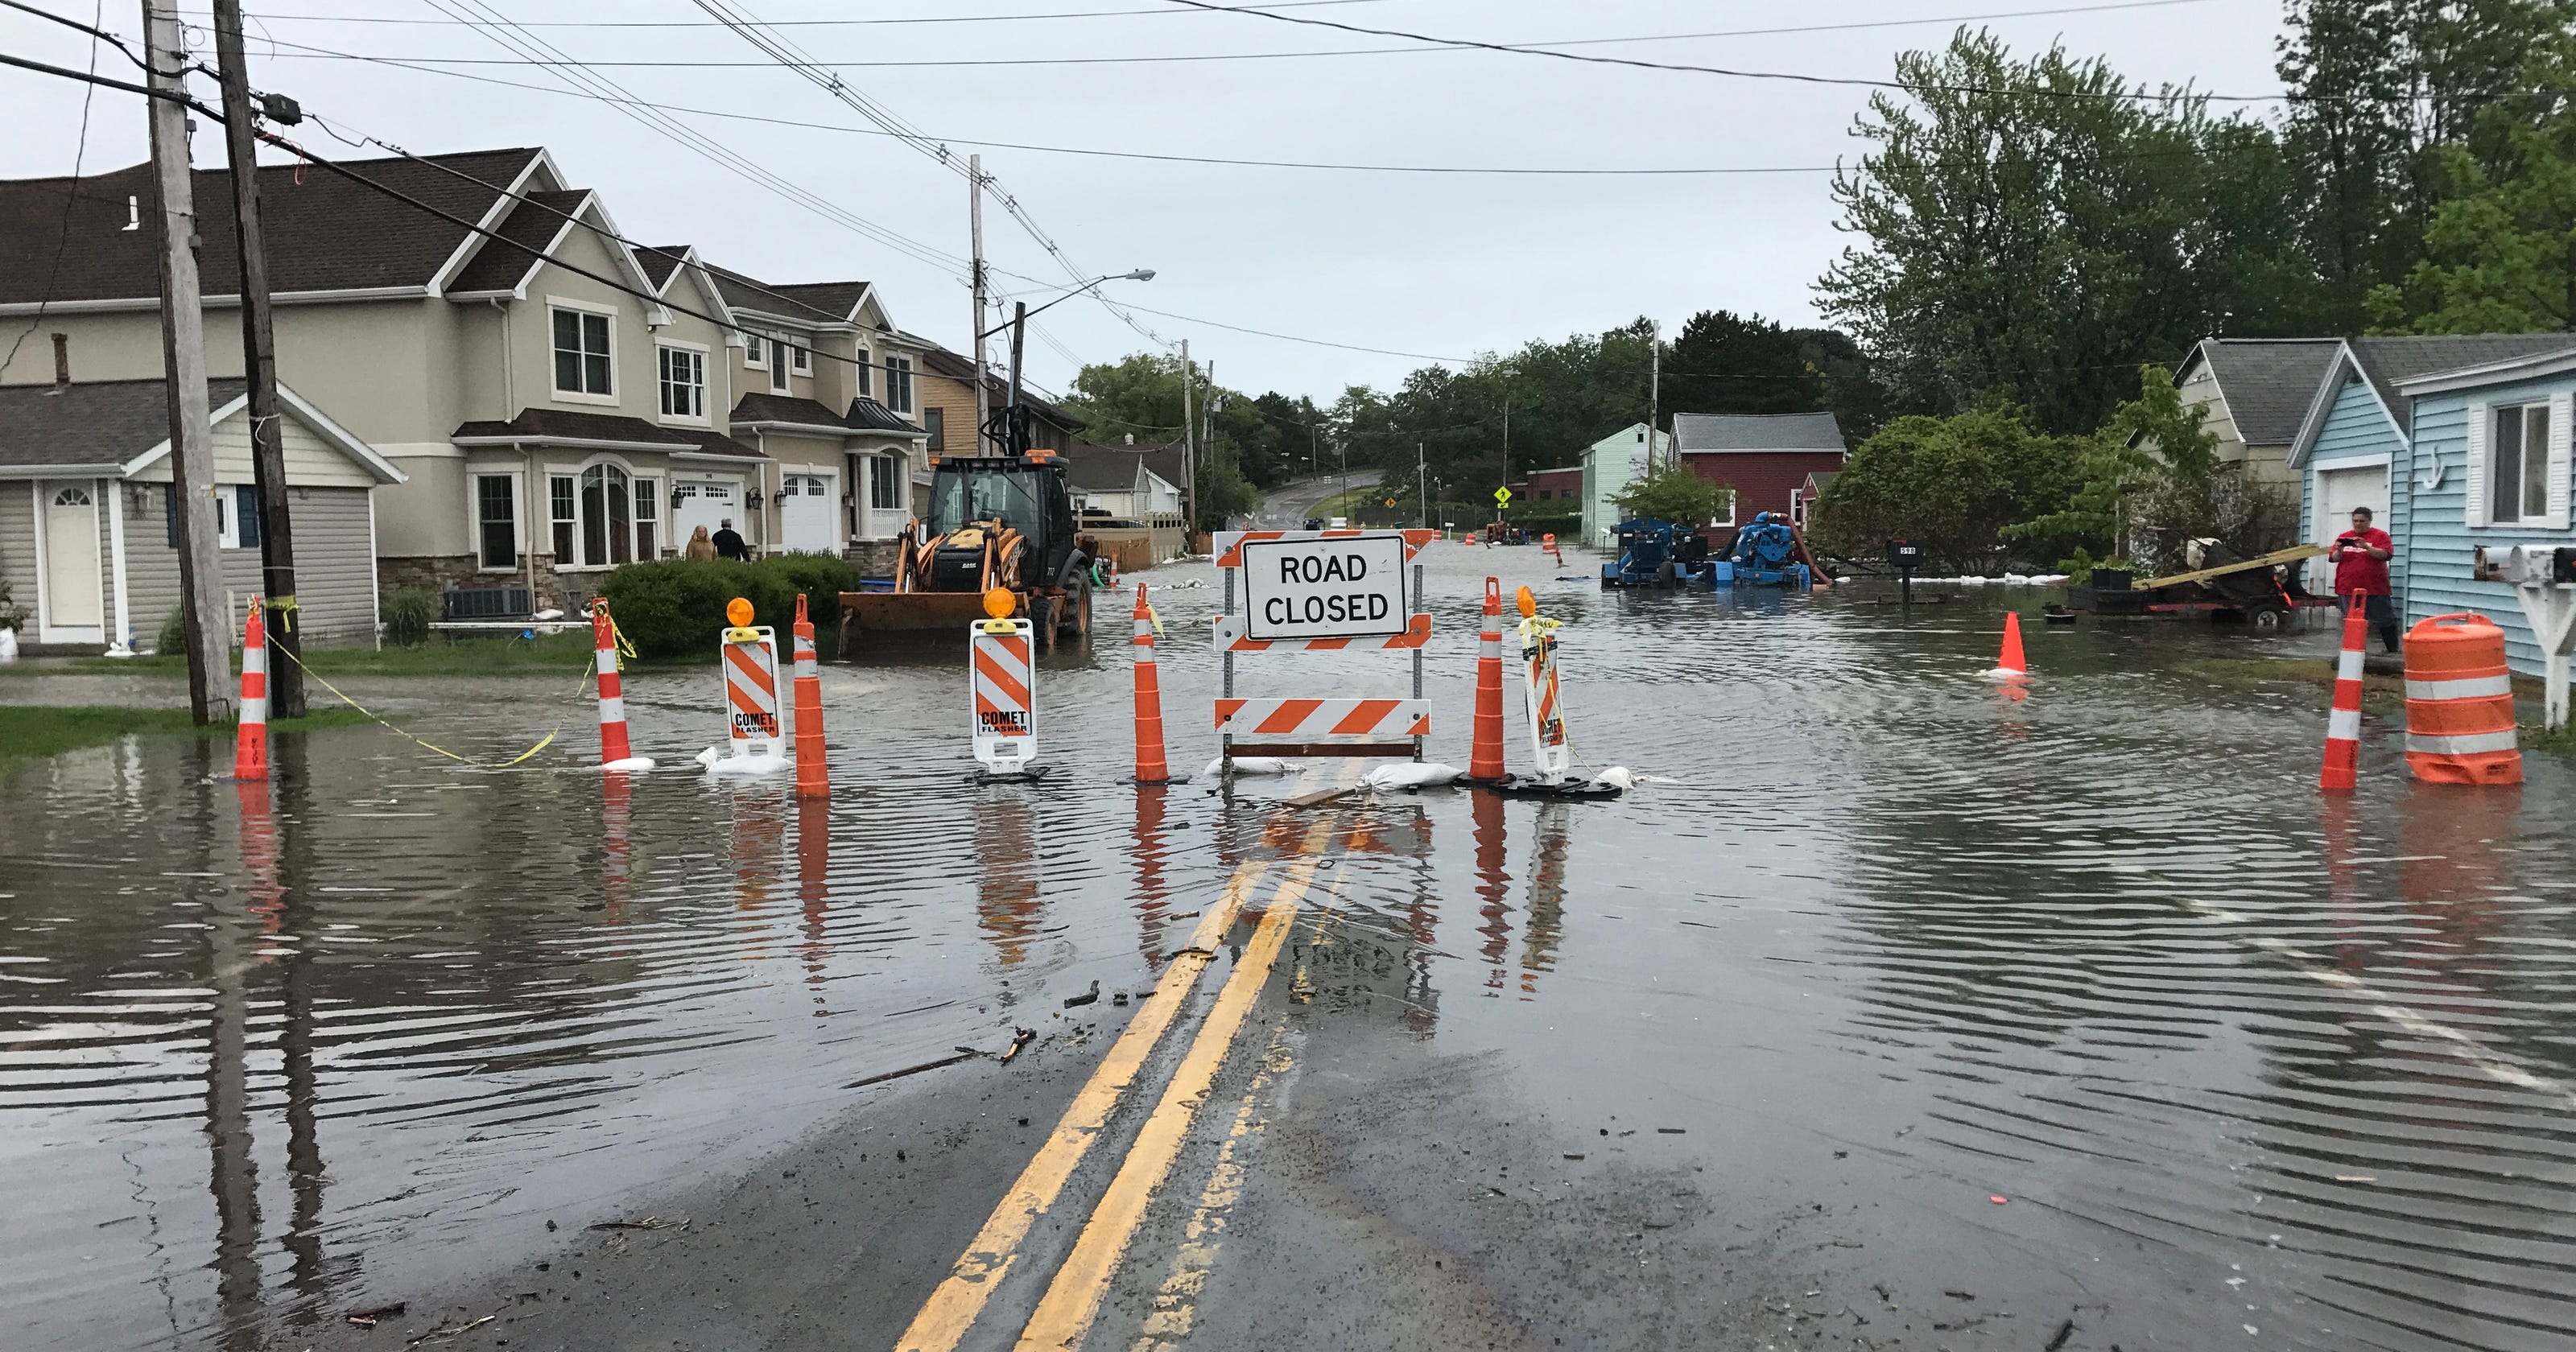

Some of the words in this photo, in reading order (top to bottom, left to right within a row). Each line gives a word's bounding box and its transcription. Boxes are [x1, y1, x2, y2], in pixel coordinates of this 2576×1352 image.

[1281, 554, 1367, 583] ROAD
[1265, 593, 1389, 625] CLOSED
[735, 713, 774, 726] COMET
[981, 711, 1026, 724] COMET
